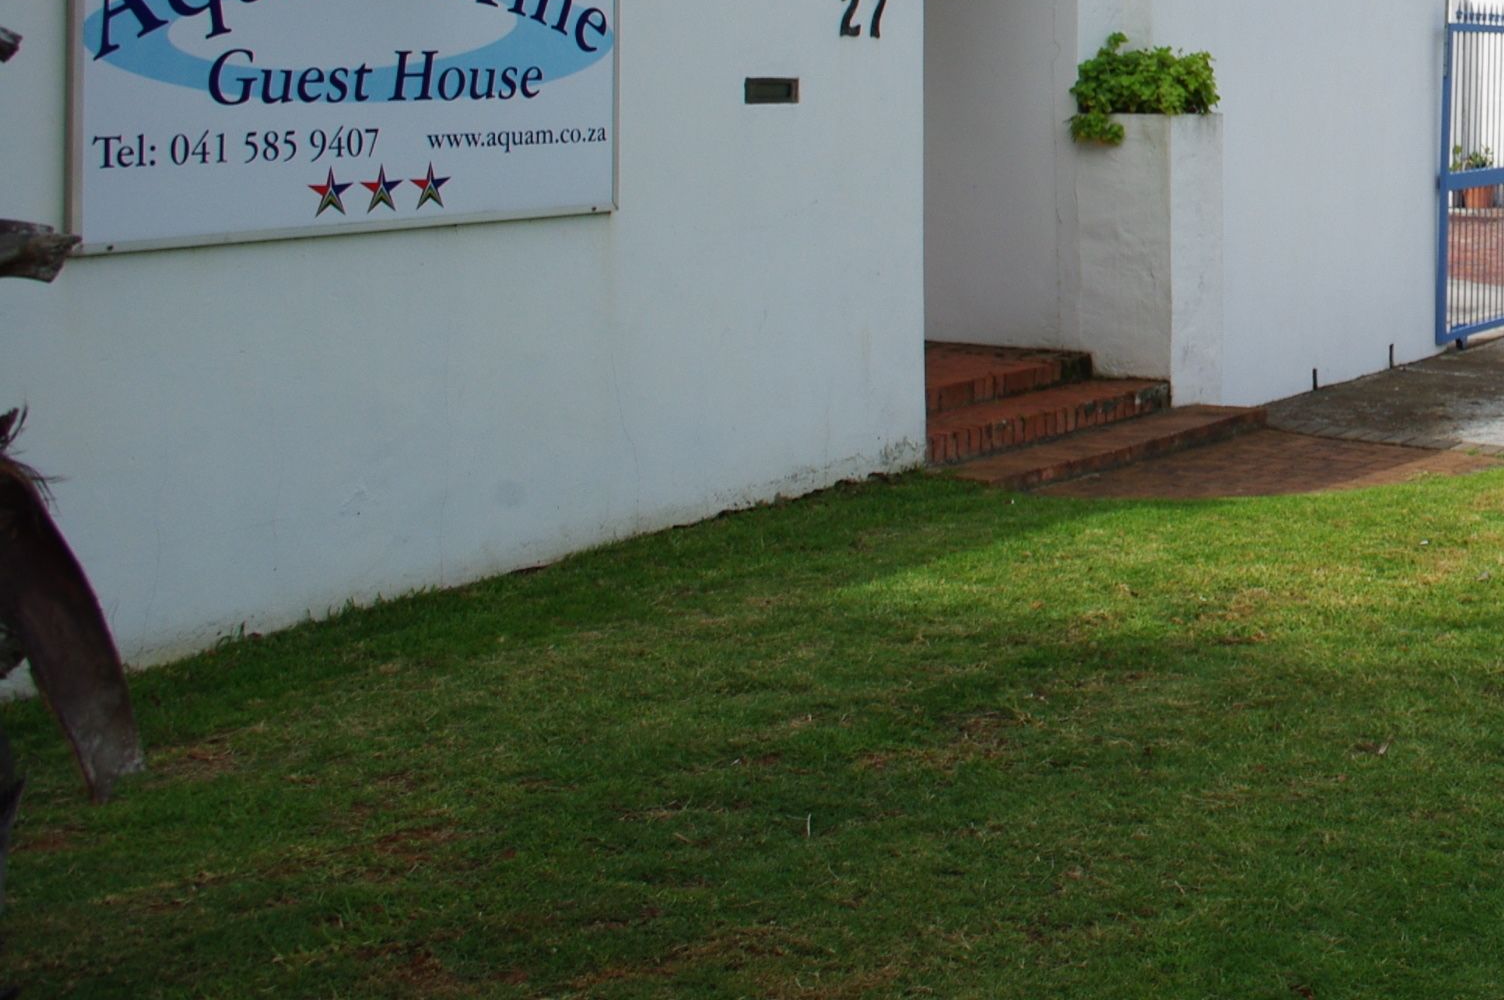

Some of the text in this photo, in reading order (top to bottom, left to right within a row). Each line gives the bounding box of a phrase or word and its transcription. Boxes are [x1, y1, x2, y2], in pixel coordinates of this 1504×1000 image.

[207, 48, 544, 107] Guest House
[92, 126, 380, 169] Tel: 041 585 9407
[427, 126, 608, 153] www.aquam.co.za
